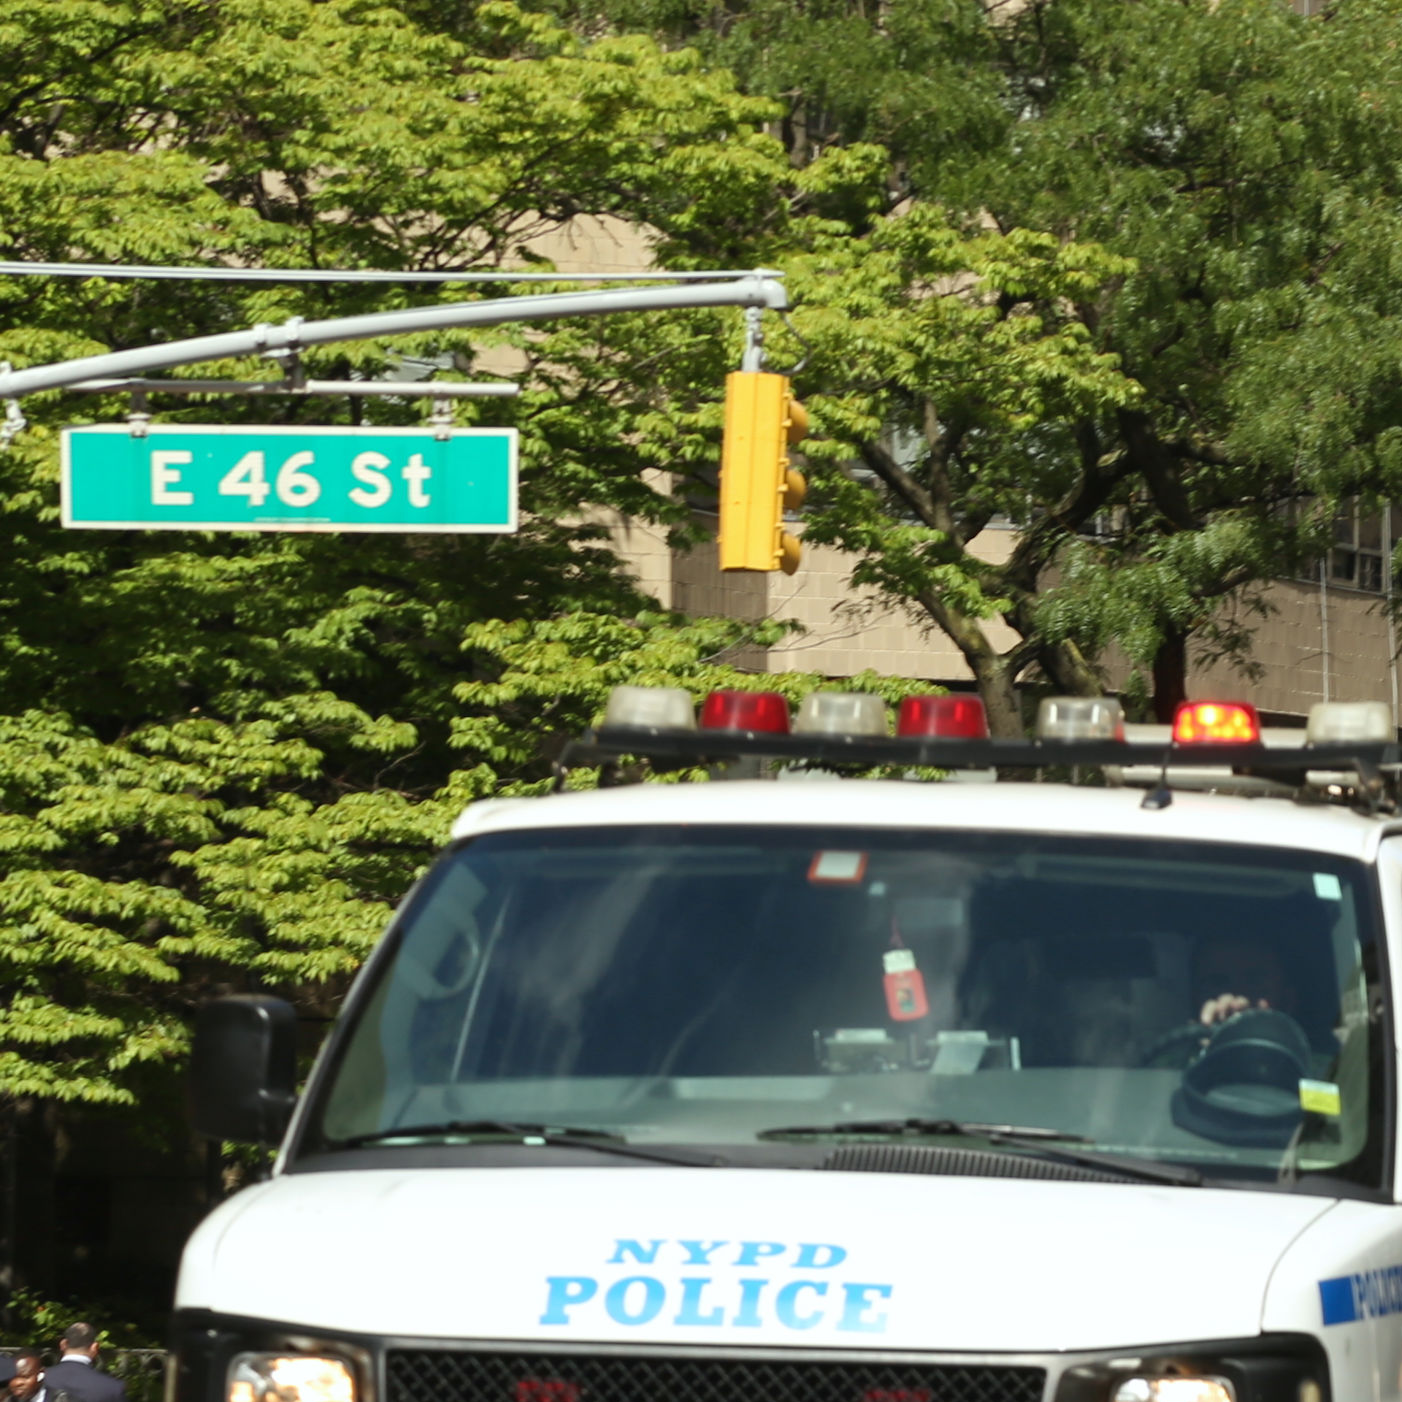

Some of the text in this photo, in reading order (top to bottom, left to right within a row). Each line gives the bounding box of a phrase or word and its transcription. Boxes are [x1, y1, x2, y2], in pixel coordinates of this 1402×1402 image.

[151, 450, 432, 508] E 46 St
[605, 1239, 848, 1268] NYPD
[539, 1276, 893, 1333] POLICE
